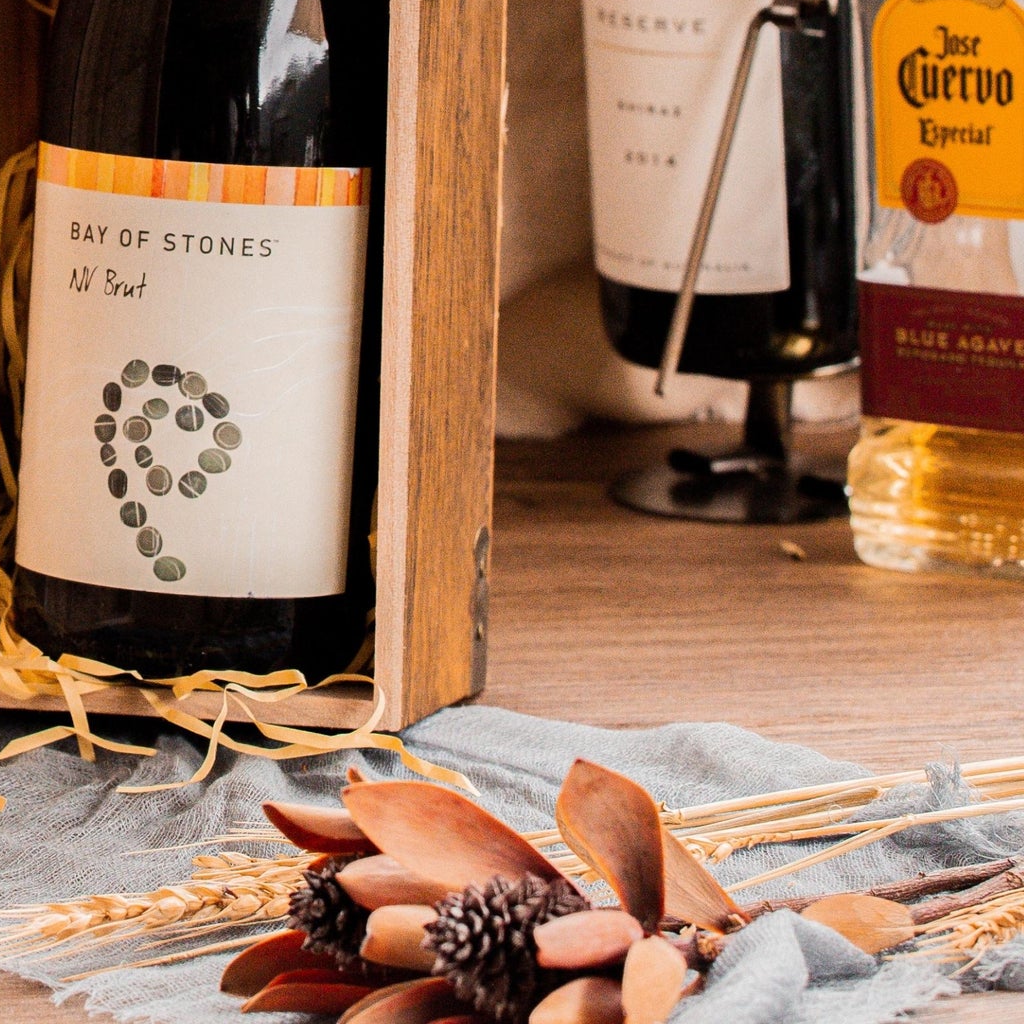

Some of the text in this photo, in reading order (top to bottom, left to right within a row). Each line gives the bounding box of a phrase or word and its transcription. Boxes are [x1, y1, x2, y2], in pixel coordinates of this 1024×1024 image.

[596, 6, 706, 35] RESERVE
[936, 25, 981, 60] Jose
[898, 46, 1014, 109] Cuervo
[919, 117, 994, 148] Especial
[70, 221, 108, 245] BAY
[119, 228, 150, 249] OF
[69, 265, 147, 299] NV Brut
[895, 327, 949, 349] BLUE
